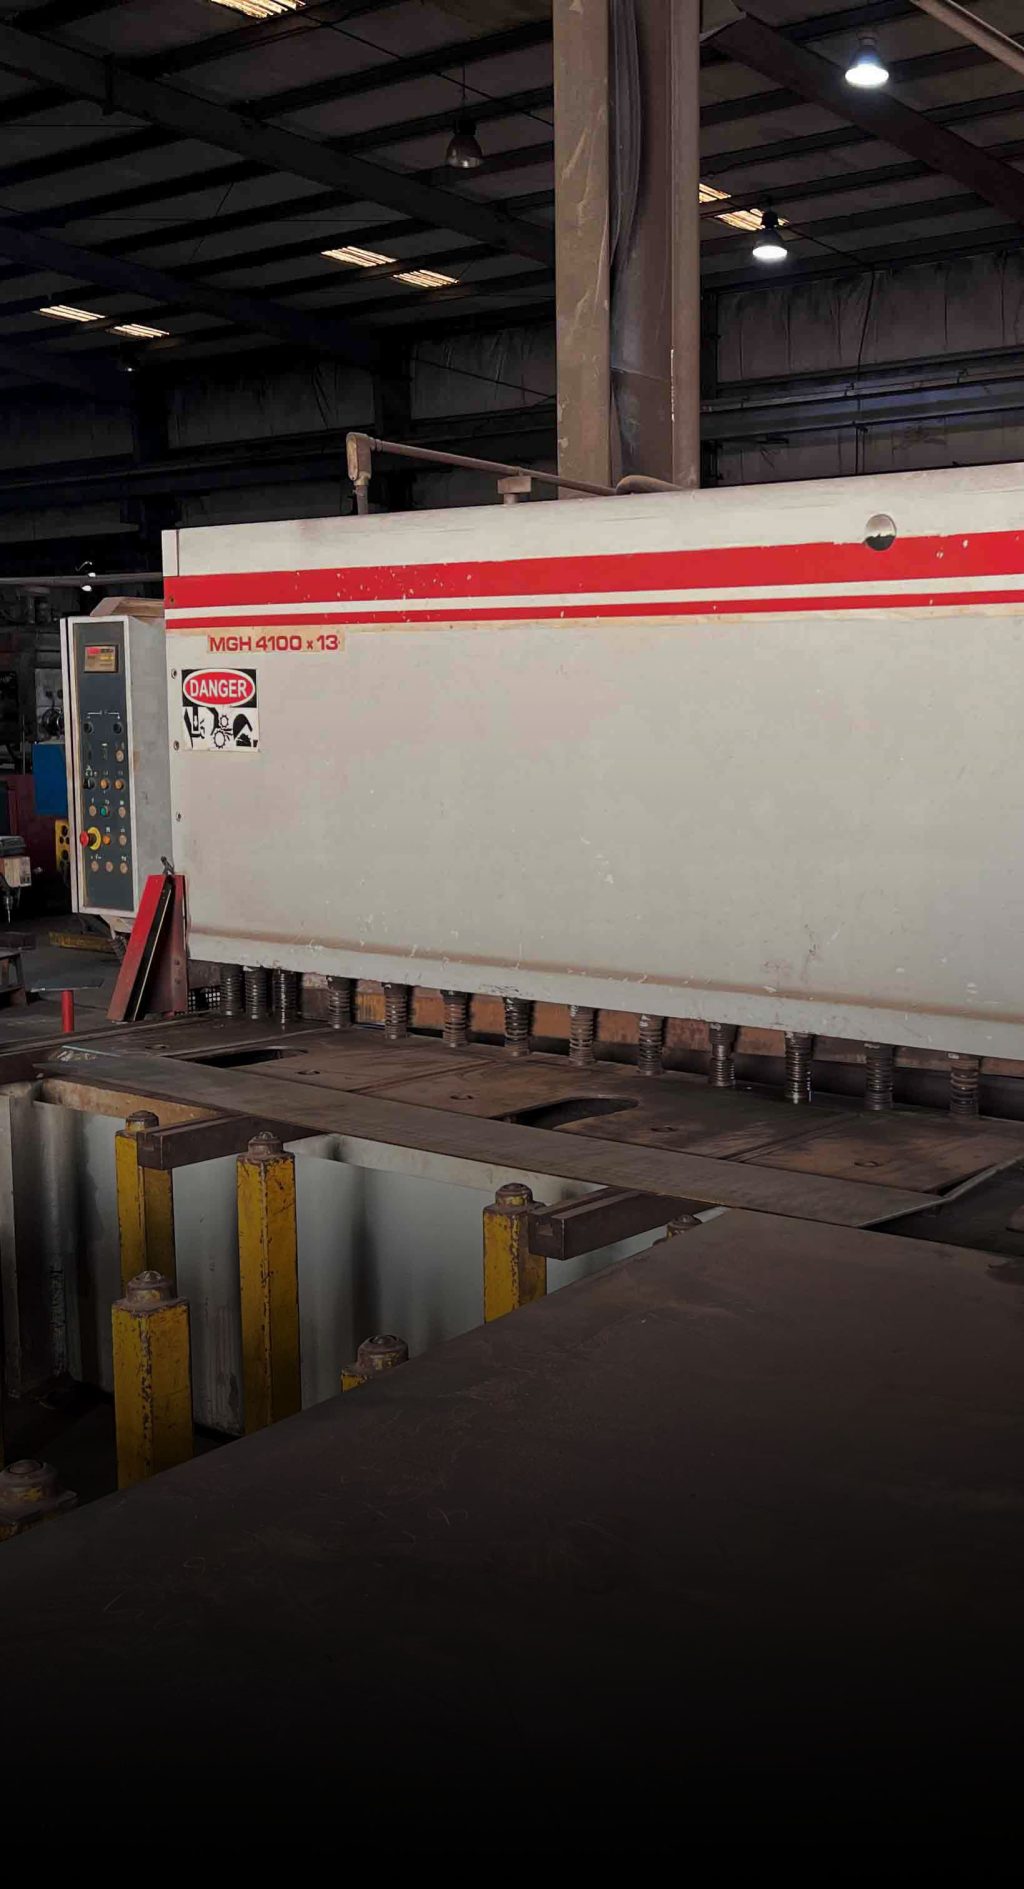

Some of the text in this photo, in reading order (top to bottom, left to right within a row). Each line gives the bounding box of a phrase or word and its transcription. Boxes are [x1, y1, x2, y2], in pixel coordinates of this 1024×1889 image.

[209, 636, 252, 652] MGH
[255, 635, 302, 651] 4100
[316, 634, 339, 651] 13
[189, 679, 248, 698] DANGER
